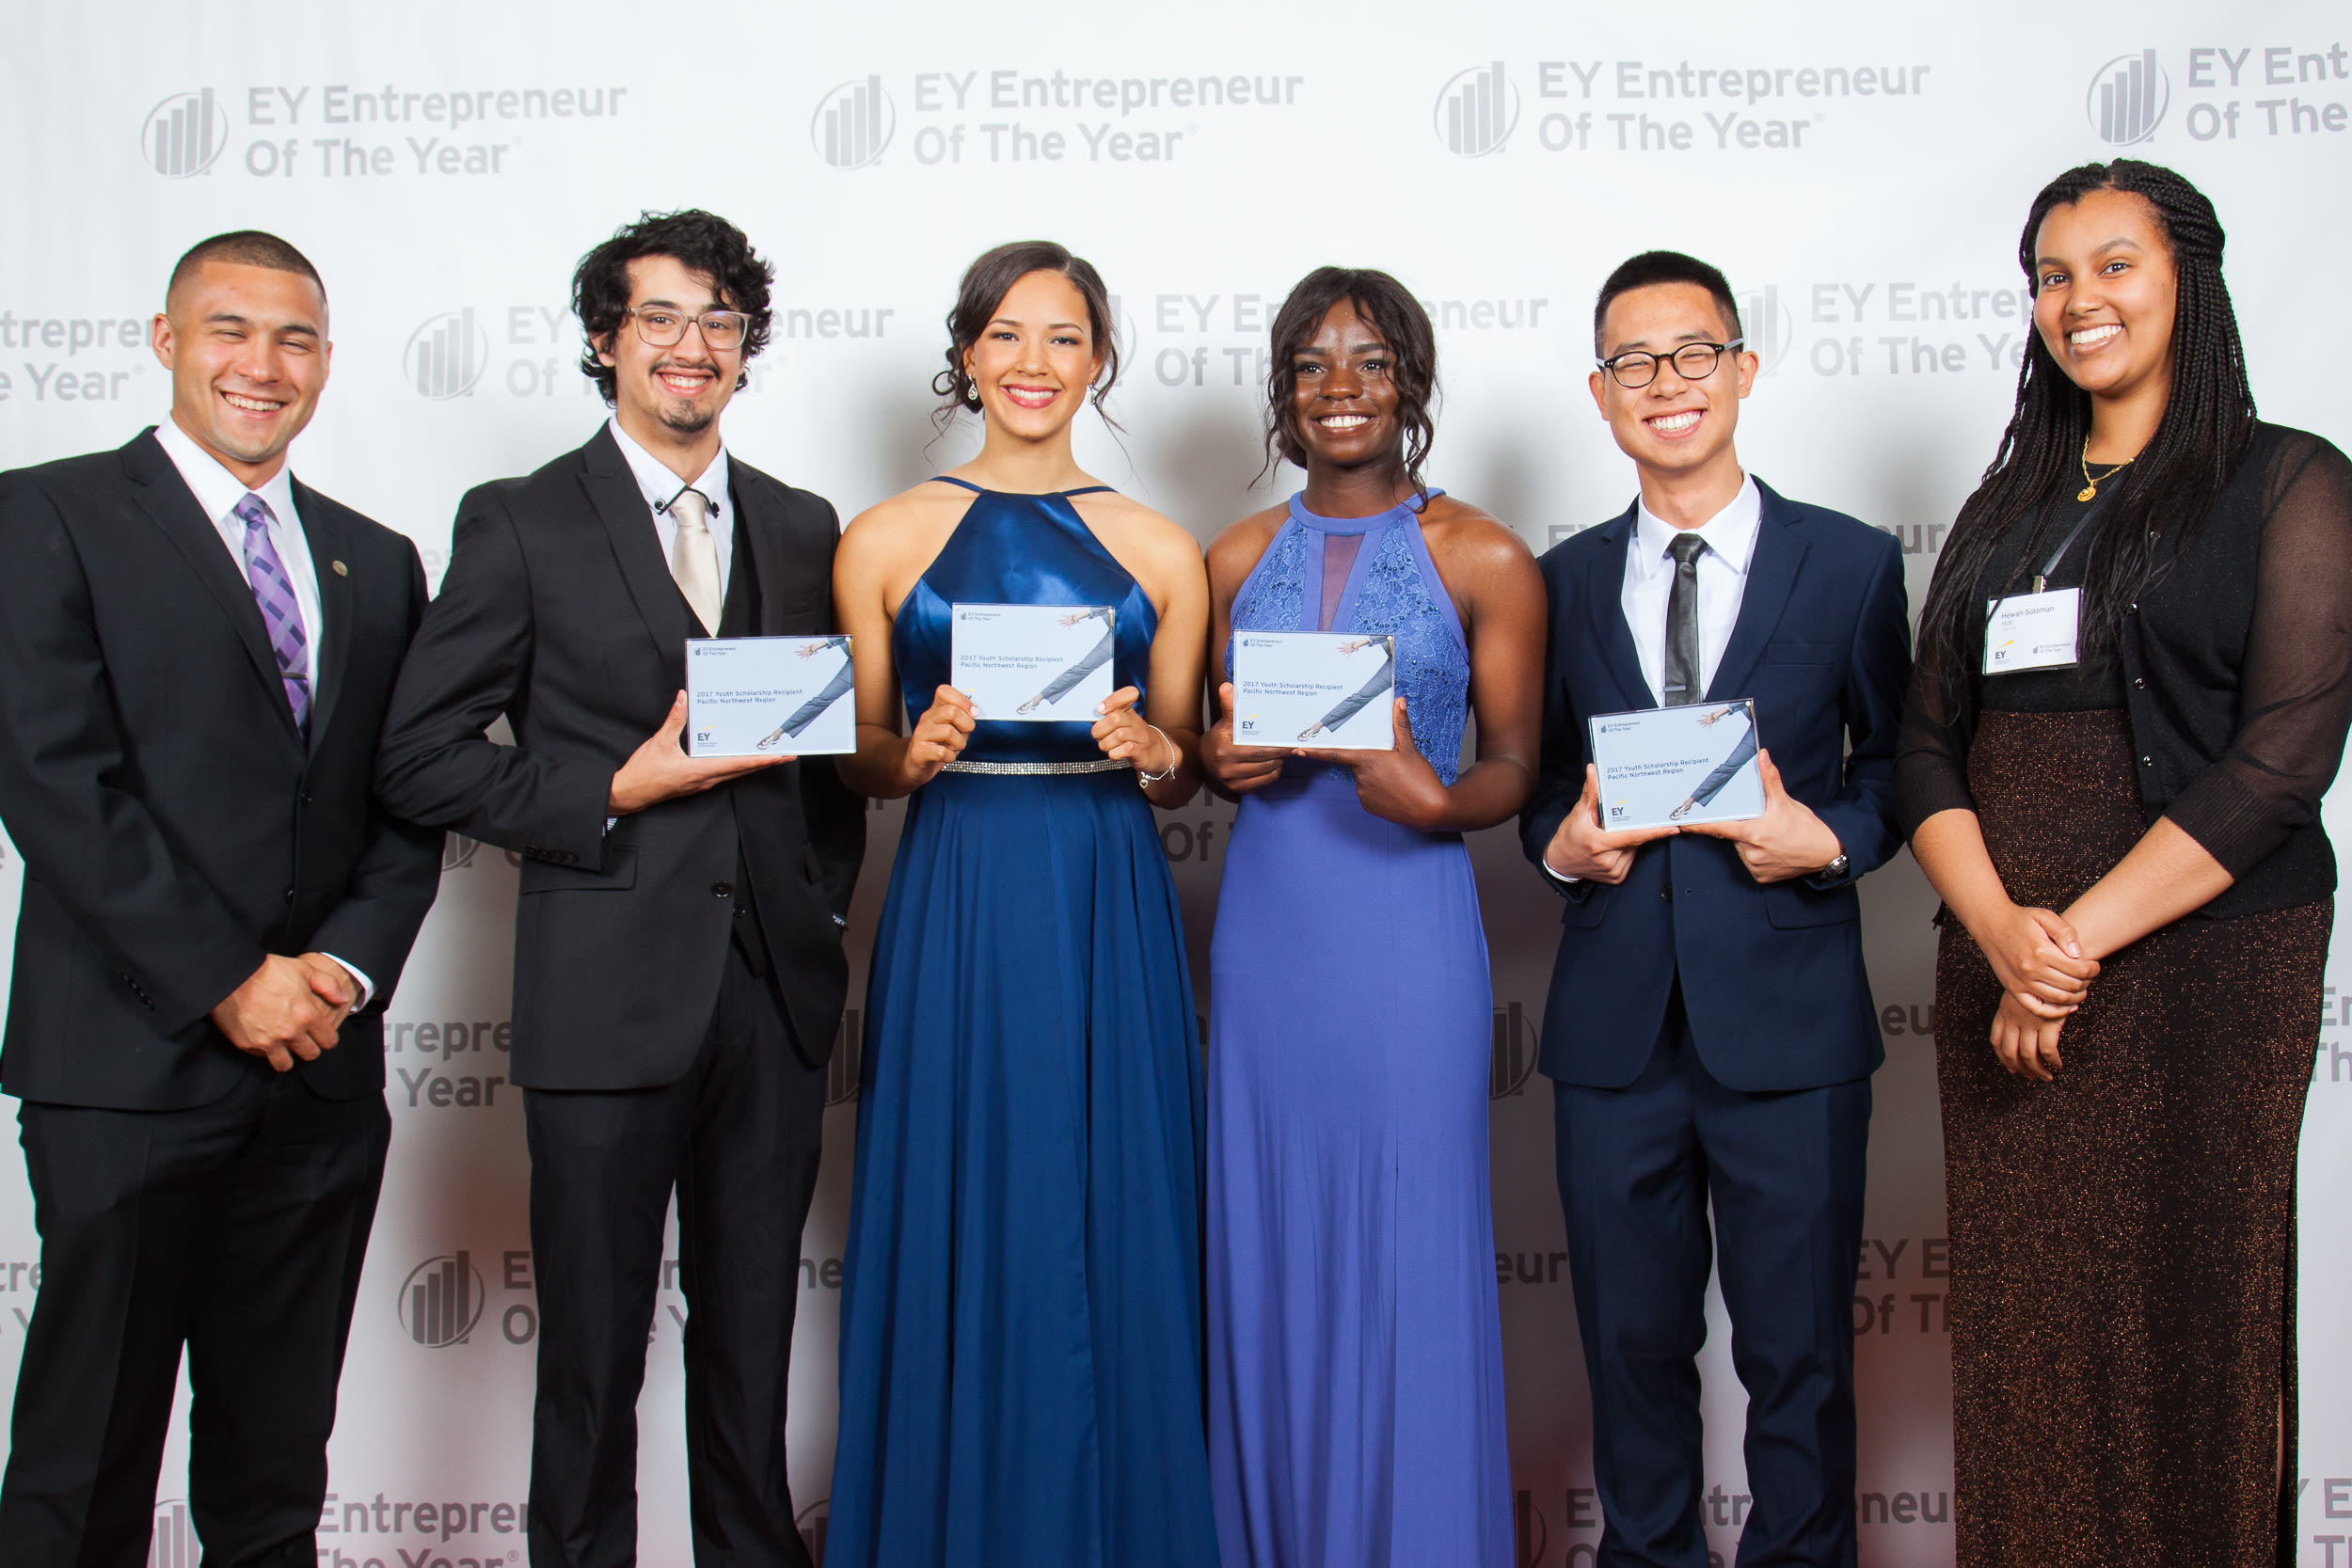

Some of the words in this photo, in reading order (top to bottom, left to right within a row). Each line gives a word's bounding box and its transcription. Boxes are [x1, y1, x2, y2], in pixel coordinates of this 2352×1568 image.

[1538, 61, 1603, 99] EY
[1616, 60, 1931, 105] Entrepreneur
[2188, 48, 2251, 87] EY
[247, 87, 310, 125] EY
[324, 83, 628, 131] Entrepreneur
[914, 71, 977, 111] EY
[991, 68, 1305, 117] Entrepreneur
[1538, 112, 1592, 151] Of
[1607, 113, 1692, 150] The
[2186, 101, 2240, 141] Of
[2254, 97, 2348, 135] The
[246, 138, 298, 177] Of
[312, 137, 394, 177] The
[914, 123, 964, 165] Of
[979, 122, 1066, 162] The
[1155, 294, 1220, 332] EY
[1811, 282, 1876, 322] EY
[508, 306, 570, 344] EY
[1154, 346, 1208, 387] Of
[1810, 336, 1864, 376] Of
[1878, 336, 1967, 375] The
[507, 357, 558, 397] Of
[2001, 610, 2024, 619] Hewan
[1995, 651, 2007, 659] EY
[697, 733, 710, 741] EY
[1242, 721, 1255, 730] EY
[1643, 761, 1678, 769] Scholarship
[1612, 807, 1624, 816] EY
[1159, 820, 1213, 863] Of
[395, 1067, 505, 1108] Year
[503, 1250, 532, 1290] E
[501, 1304, 536, 1346] O
